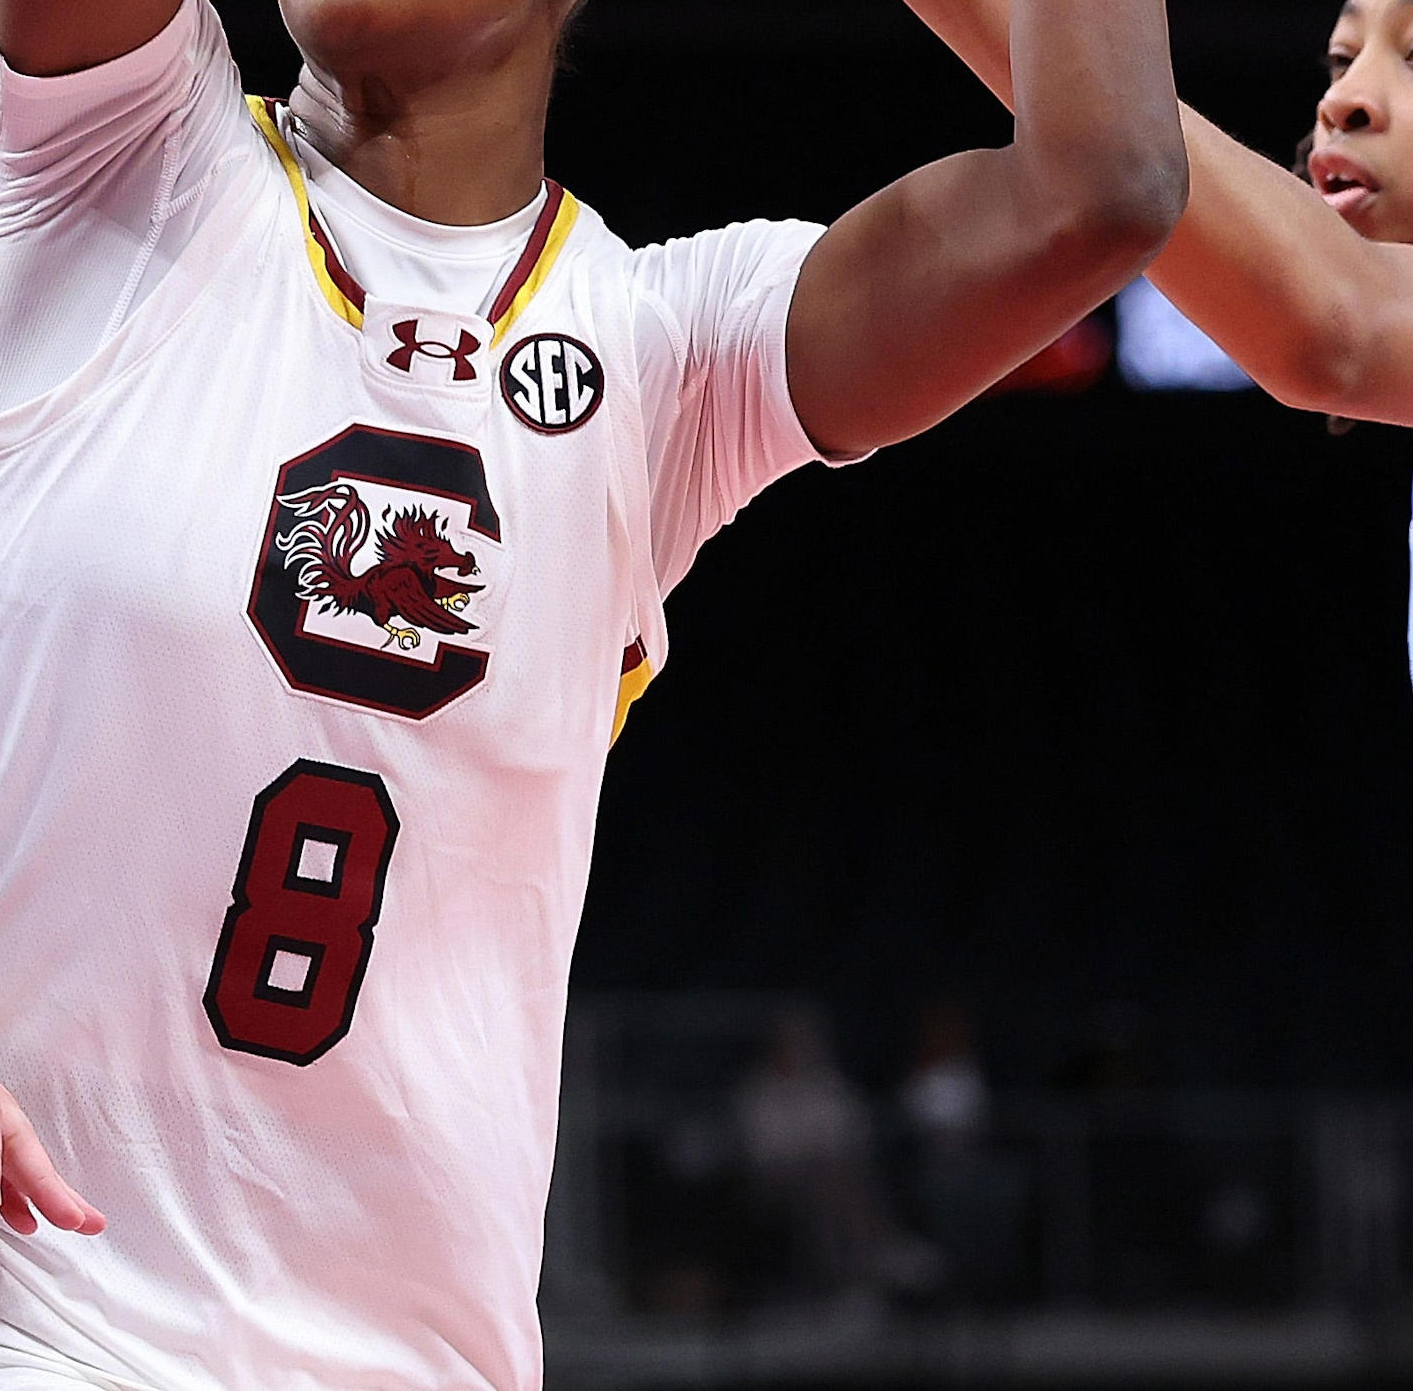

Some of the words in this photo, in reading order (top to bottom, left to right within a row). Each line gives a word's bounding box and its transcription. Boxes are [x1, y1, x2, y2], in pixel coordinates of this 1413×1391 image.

[509, 340, 595, 424] SEC
[247, 423, 501, 721] C
[202, 757, 401, 1066] 8
